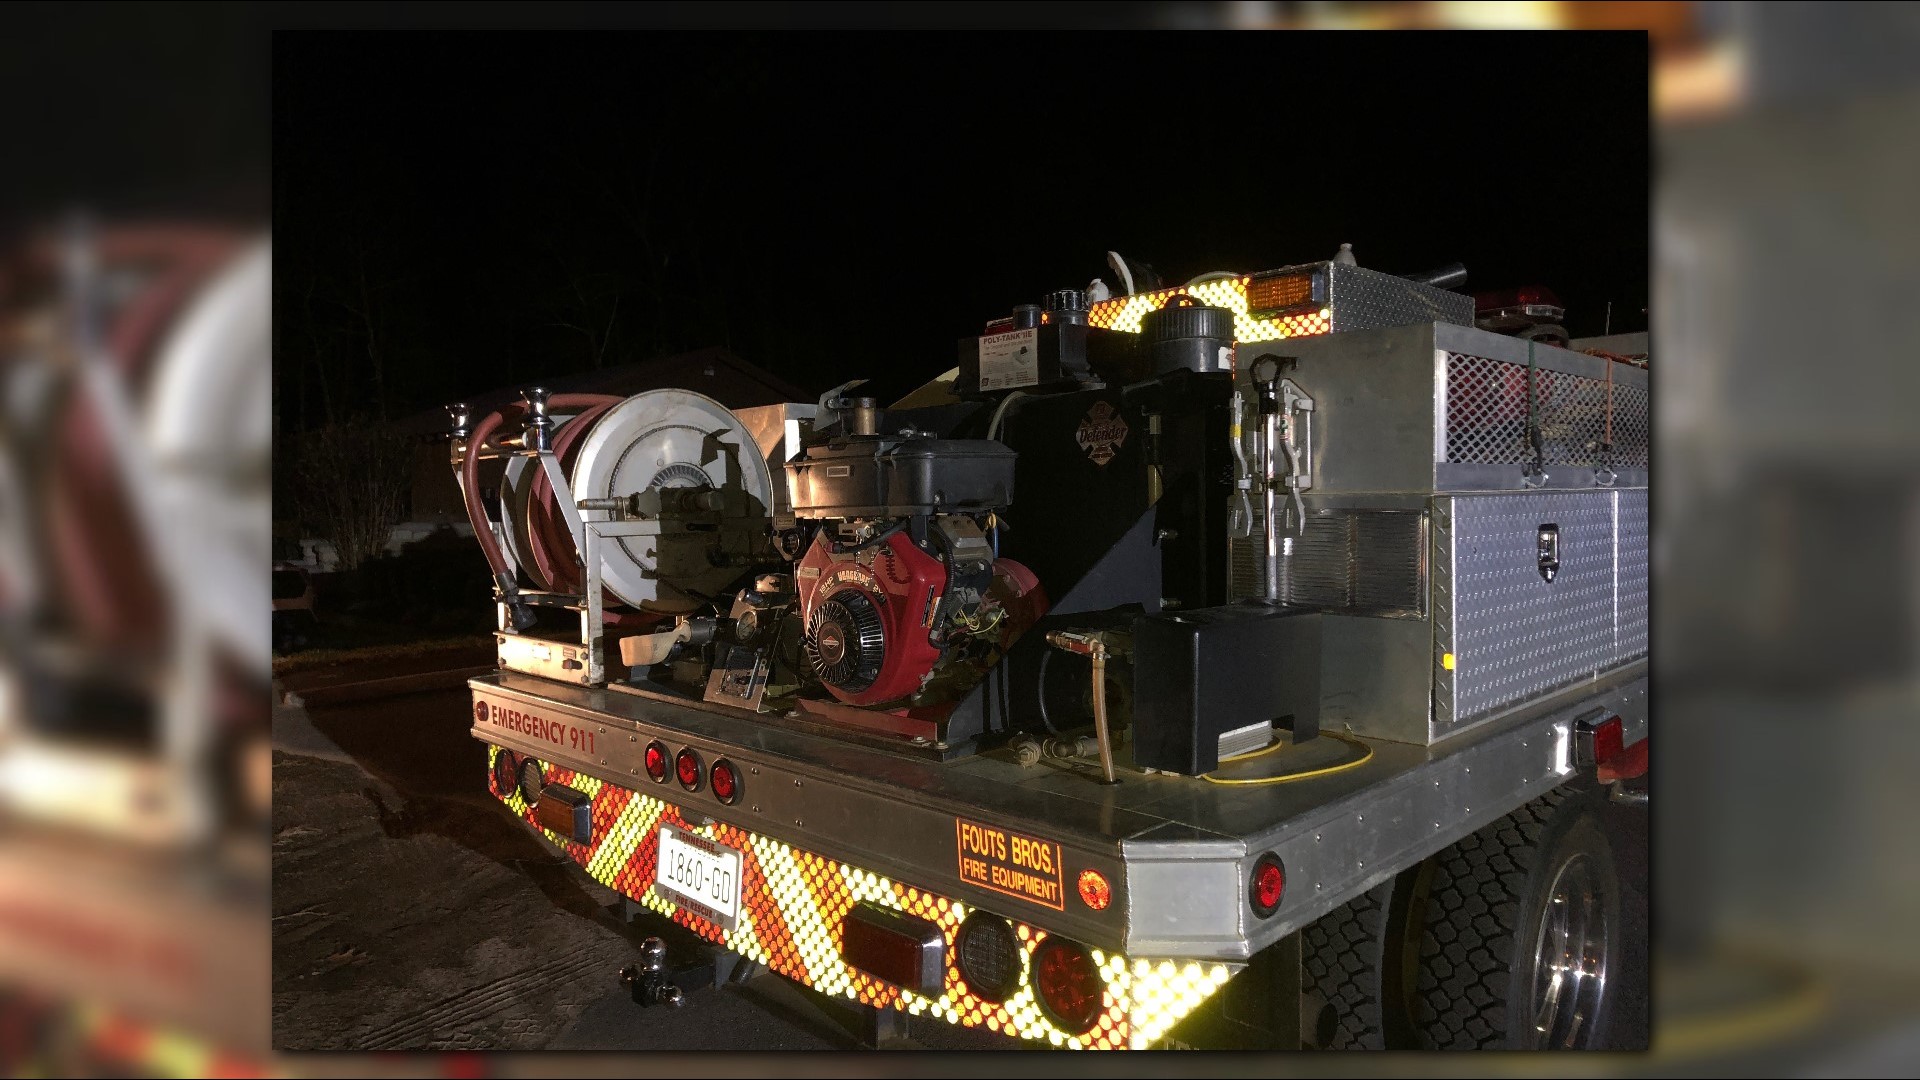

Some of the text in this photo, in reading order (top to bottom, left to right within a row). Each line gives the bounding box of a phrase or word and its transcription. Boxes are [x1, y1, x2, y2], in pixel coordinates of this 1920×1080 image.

[983, 332, 1020, 345] POLY-TANK
[1079, 424, 1127, 443] Defender
[492, 705, 595, 755] EMERGENCY 911
[678, 831, 716, 853] TENNESSEE
[962, 823, 1056, 875] FOUTS BROS.
[667, 849, 731, 904] 1860-GD
[963, 858, 1058, 902] FIRE EQUIPMENT
[675, 894, 713, 919] FIRE/RESCUE
